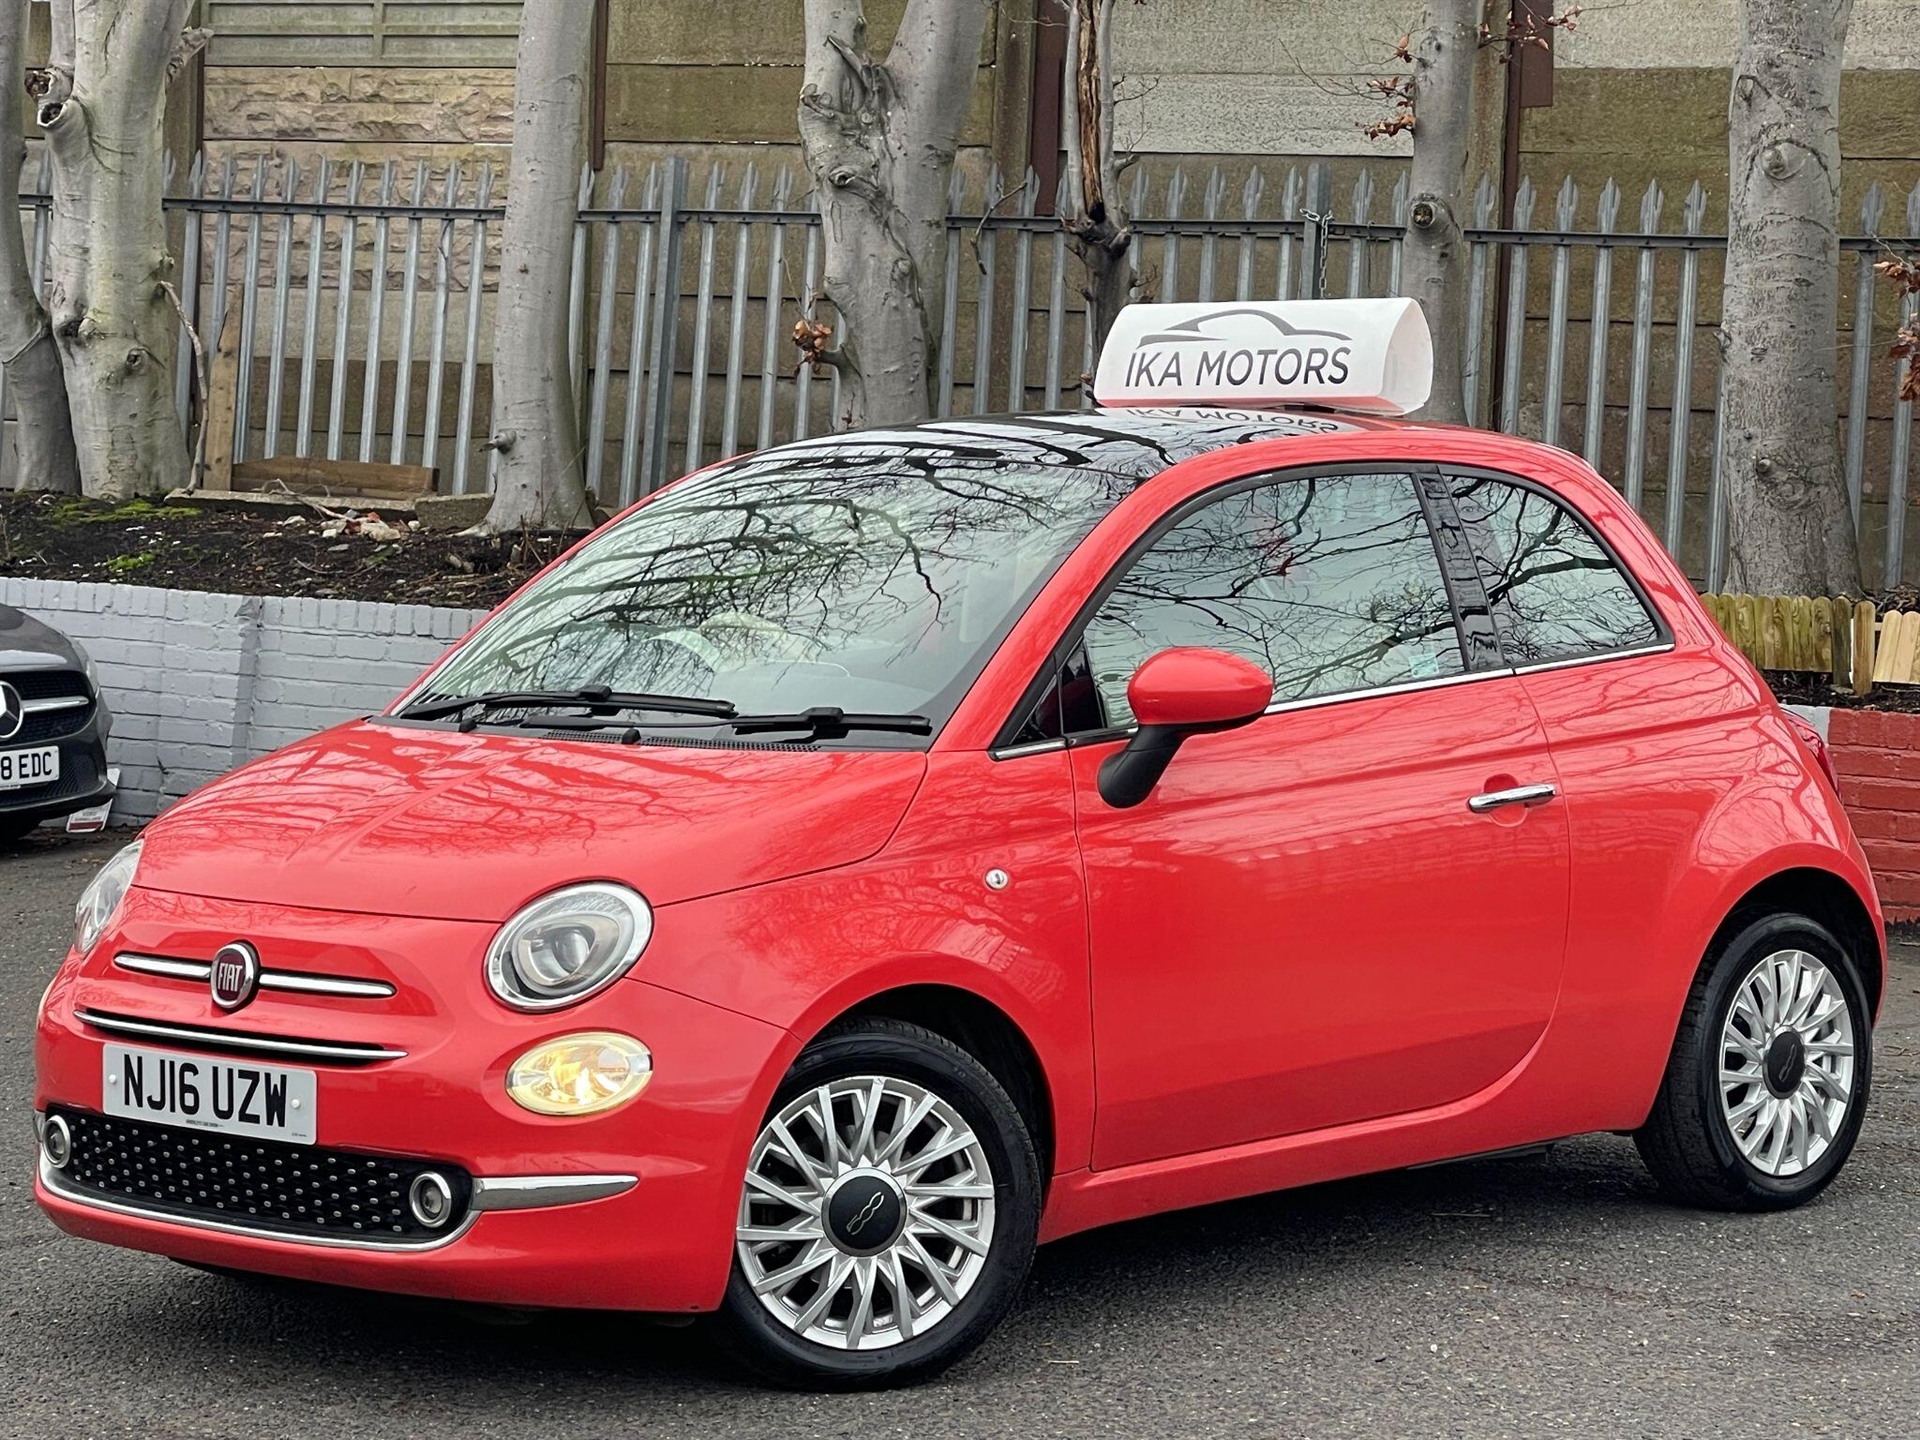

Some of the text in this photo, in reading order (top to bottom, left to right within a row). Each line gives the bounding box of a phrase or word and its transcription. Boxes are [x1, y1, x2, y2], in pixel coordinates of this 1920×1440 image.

[1125, 347, 1351, 388] IKA MOTORS
[18, 751, 53, 780] EDC
[217, 962, 243, 992] FIAT
[123, 1053, 288, 1128] NJ16 UZW
